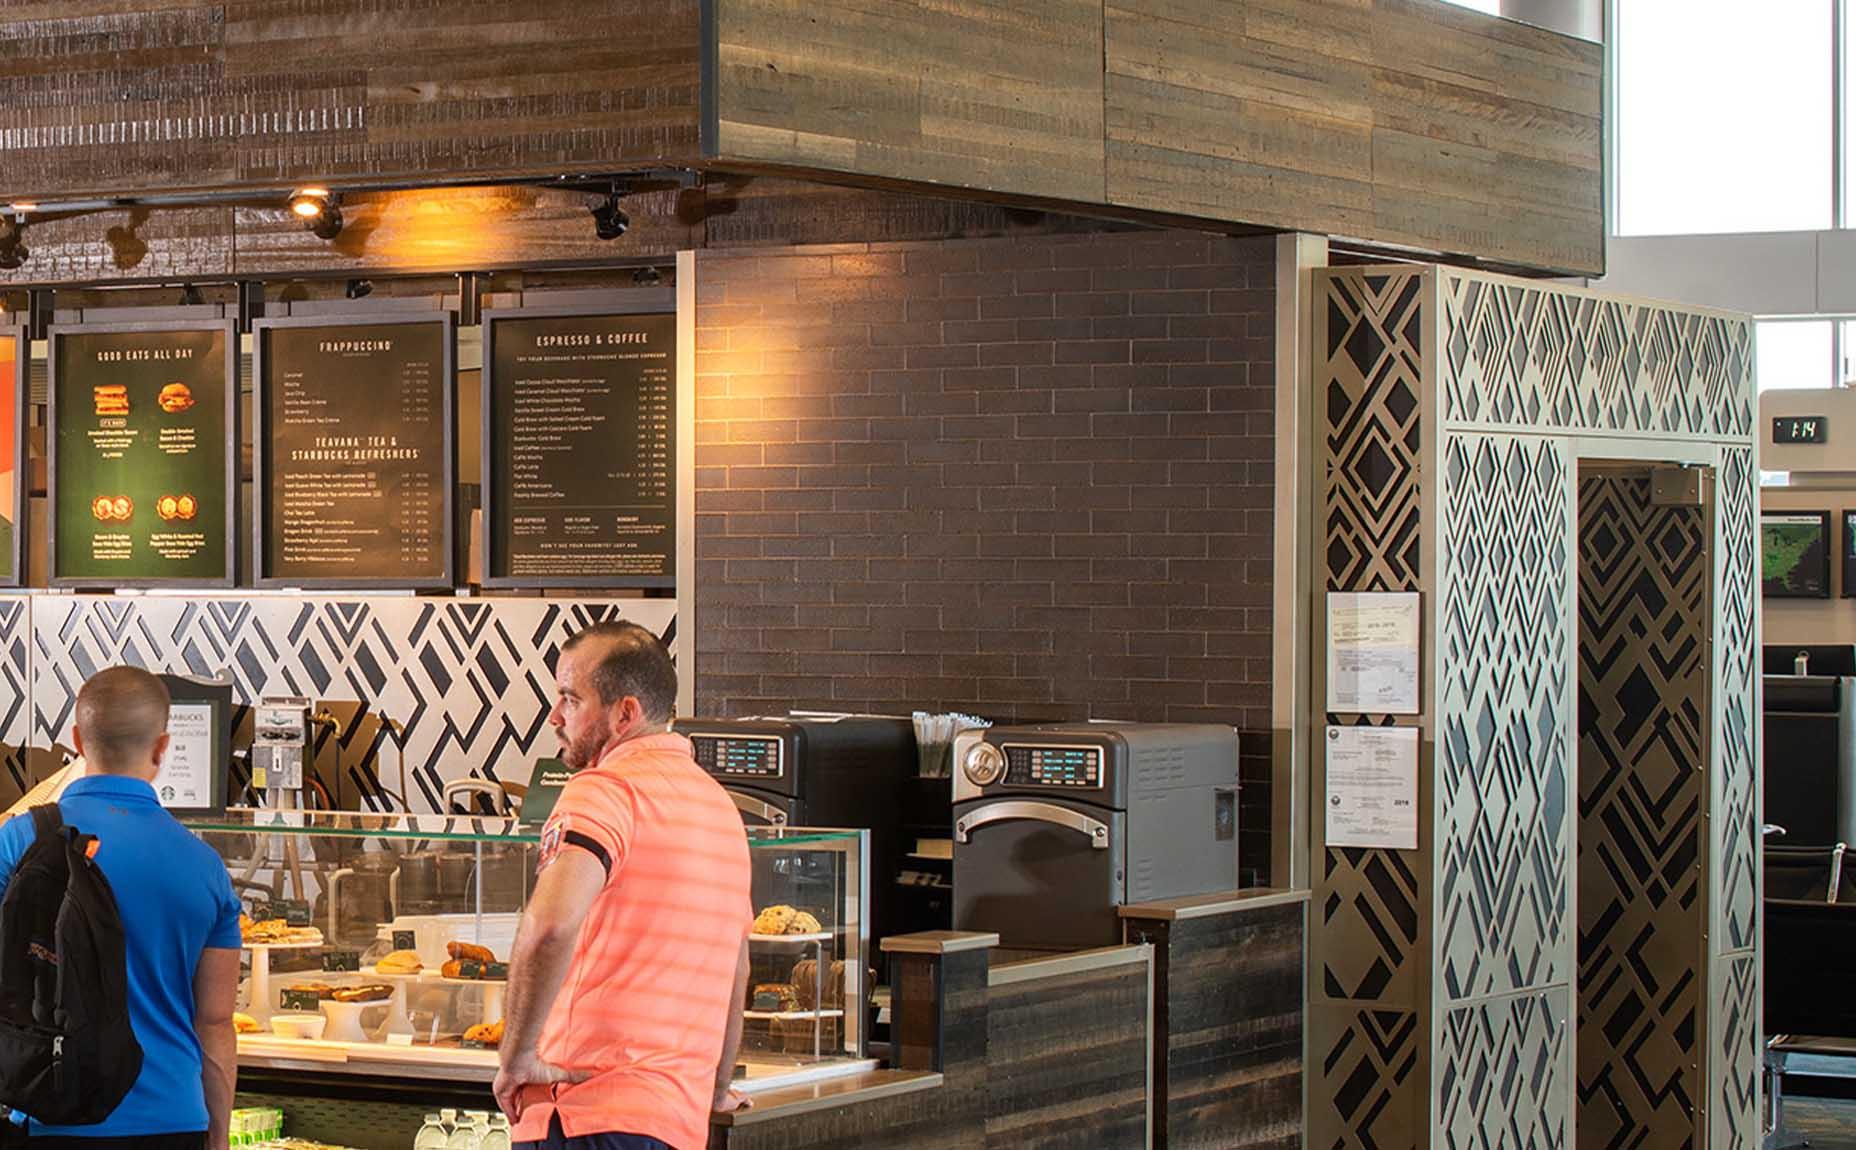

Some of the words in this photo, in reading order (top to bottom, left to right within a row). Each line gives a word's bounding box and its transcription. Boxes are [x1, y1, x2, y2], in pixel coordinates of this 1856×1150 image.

[536, 334, 591, 346] ESPRESSO
[596, 334, 602, 345] &
[607, 333, 648, 344] COFFEE
[320, 340, 391, 352] FRAPPUCCINO
[97, 351, 121, 361] GOOD
[126, 350, 149, 361] EATS
[154, 349, 171, 359] ALL
[175, 349, 194, 359] DAY
[368, 436, 385, 447] TEA
[292, 449, 349, 460] STARBUCKS
